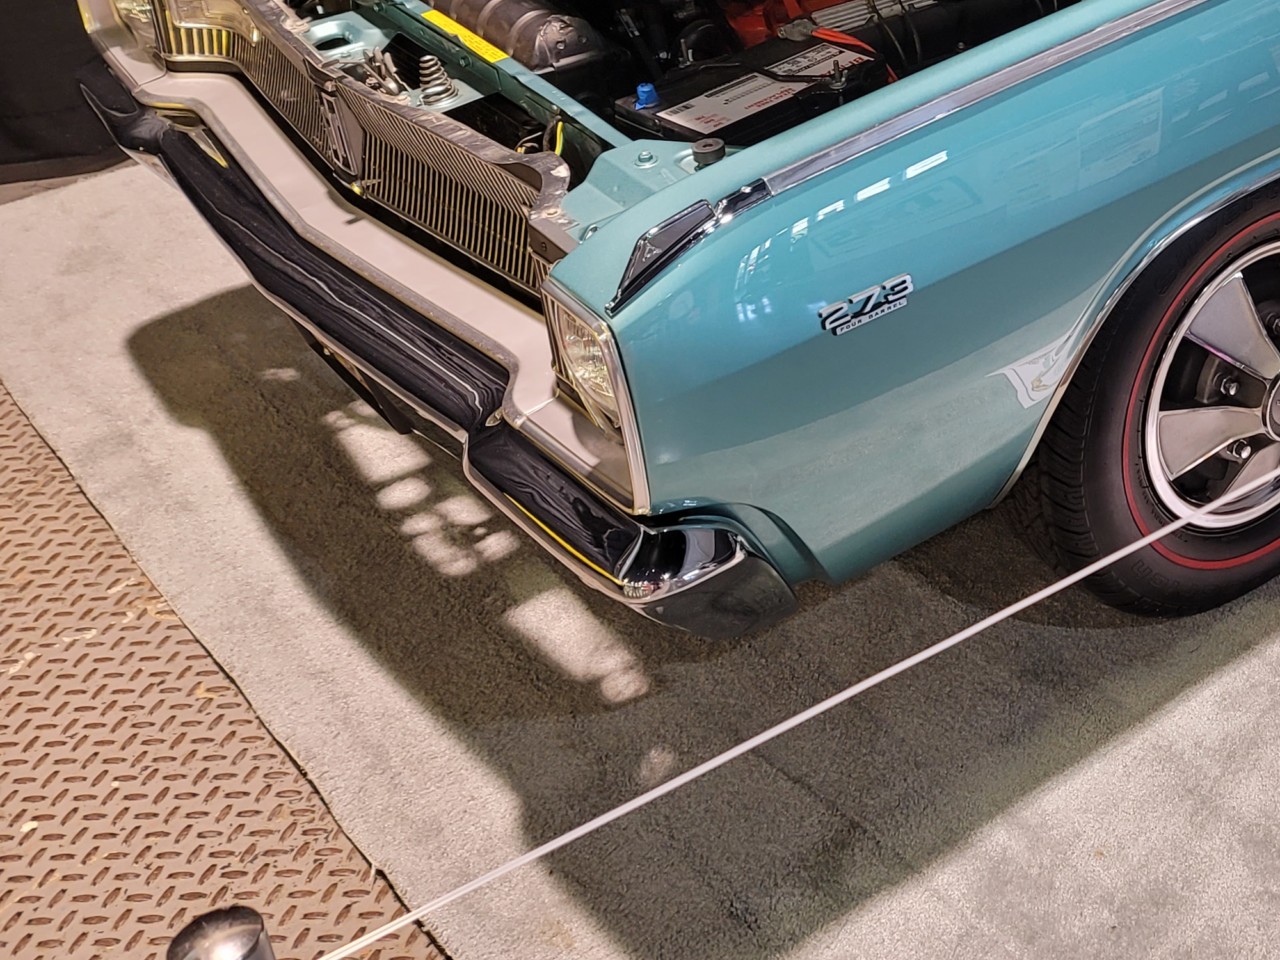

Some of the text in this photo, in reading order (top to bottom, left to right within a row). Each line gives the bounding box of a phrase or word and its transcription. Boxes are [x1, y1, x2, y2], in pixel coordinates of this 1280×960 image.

[818, 272, 914, 331] 273
[839, 301, 904, 333] FOUR BARREL
